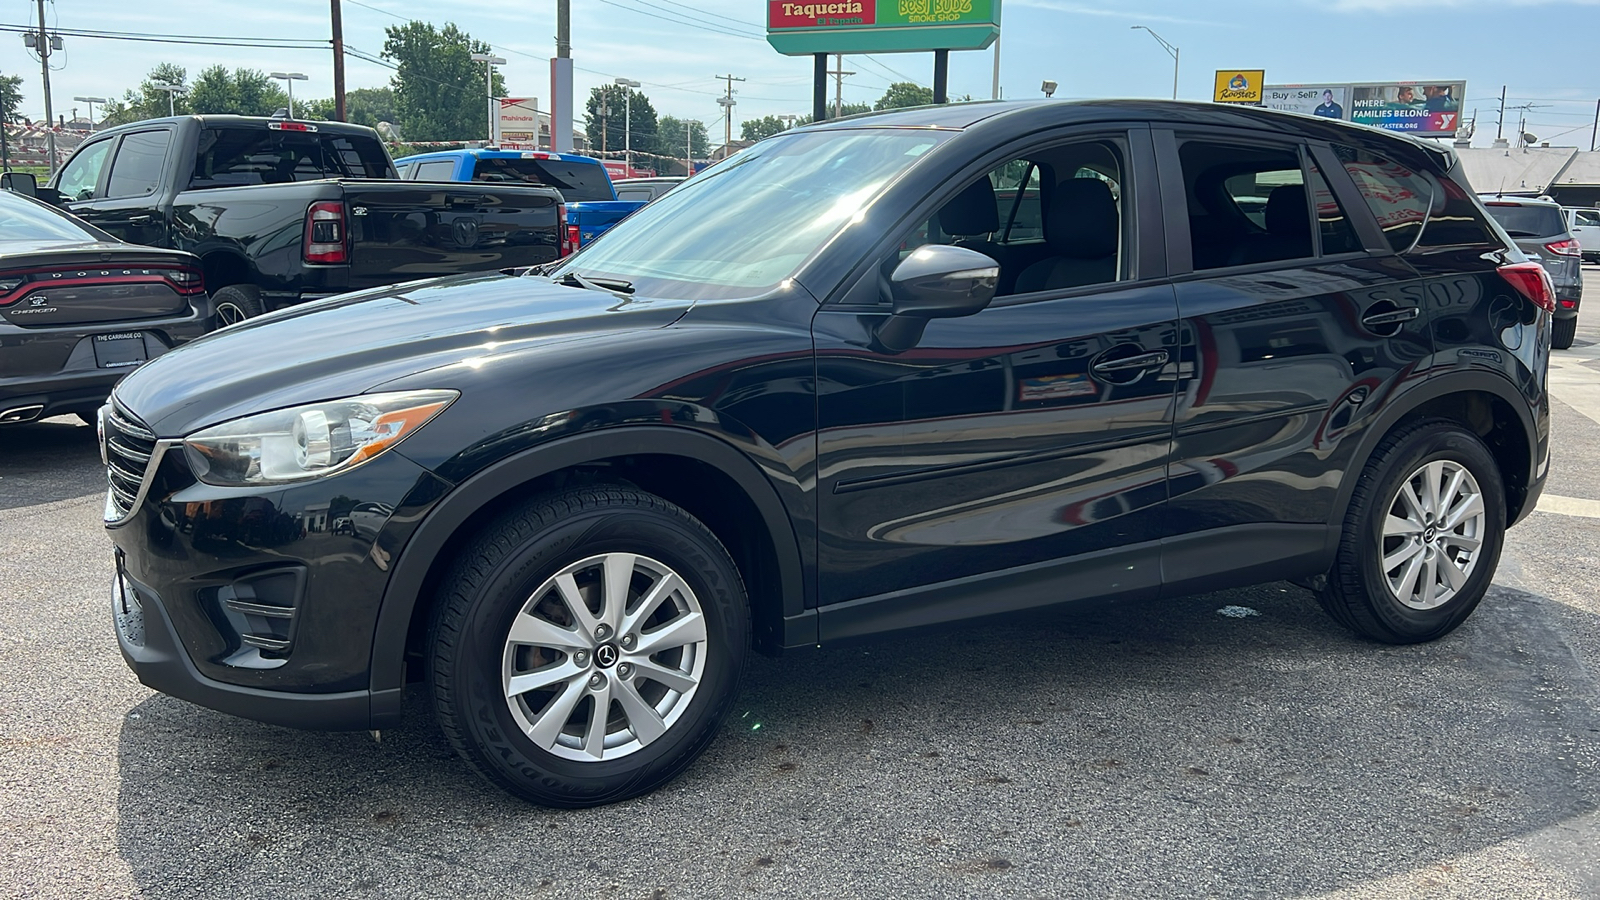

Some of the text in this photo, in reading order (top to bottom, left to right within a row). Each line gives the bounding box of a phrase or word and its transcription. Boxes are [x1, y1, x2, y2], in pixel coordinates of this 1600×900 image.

[817, 17, 826, 25] El
[908, 13, 960, 23] SMOKE SHOP
[1220, 88, 1257, 100] Roosters
[1272, 92, 1289, 100] Buy
[1297, 91, 1318, 99] Sell?
[1354, 100, 1385, 108] WHERE
[1353, 109, 1432, 118] FAMILIES BELONG.
[52, 269, 150, 278] DODGE
[10, 307, 58, 316] CHARGER
[108, 333, 133, 341] CARRIAGE
